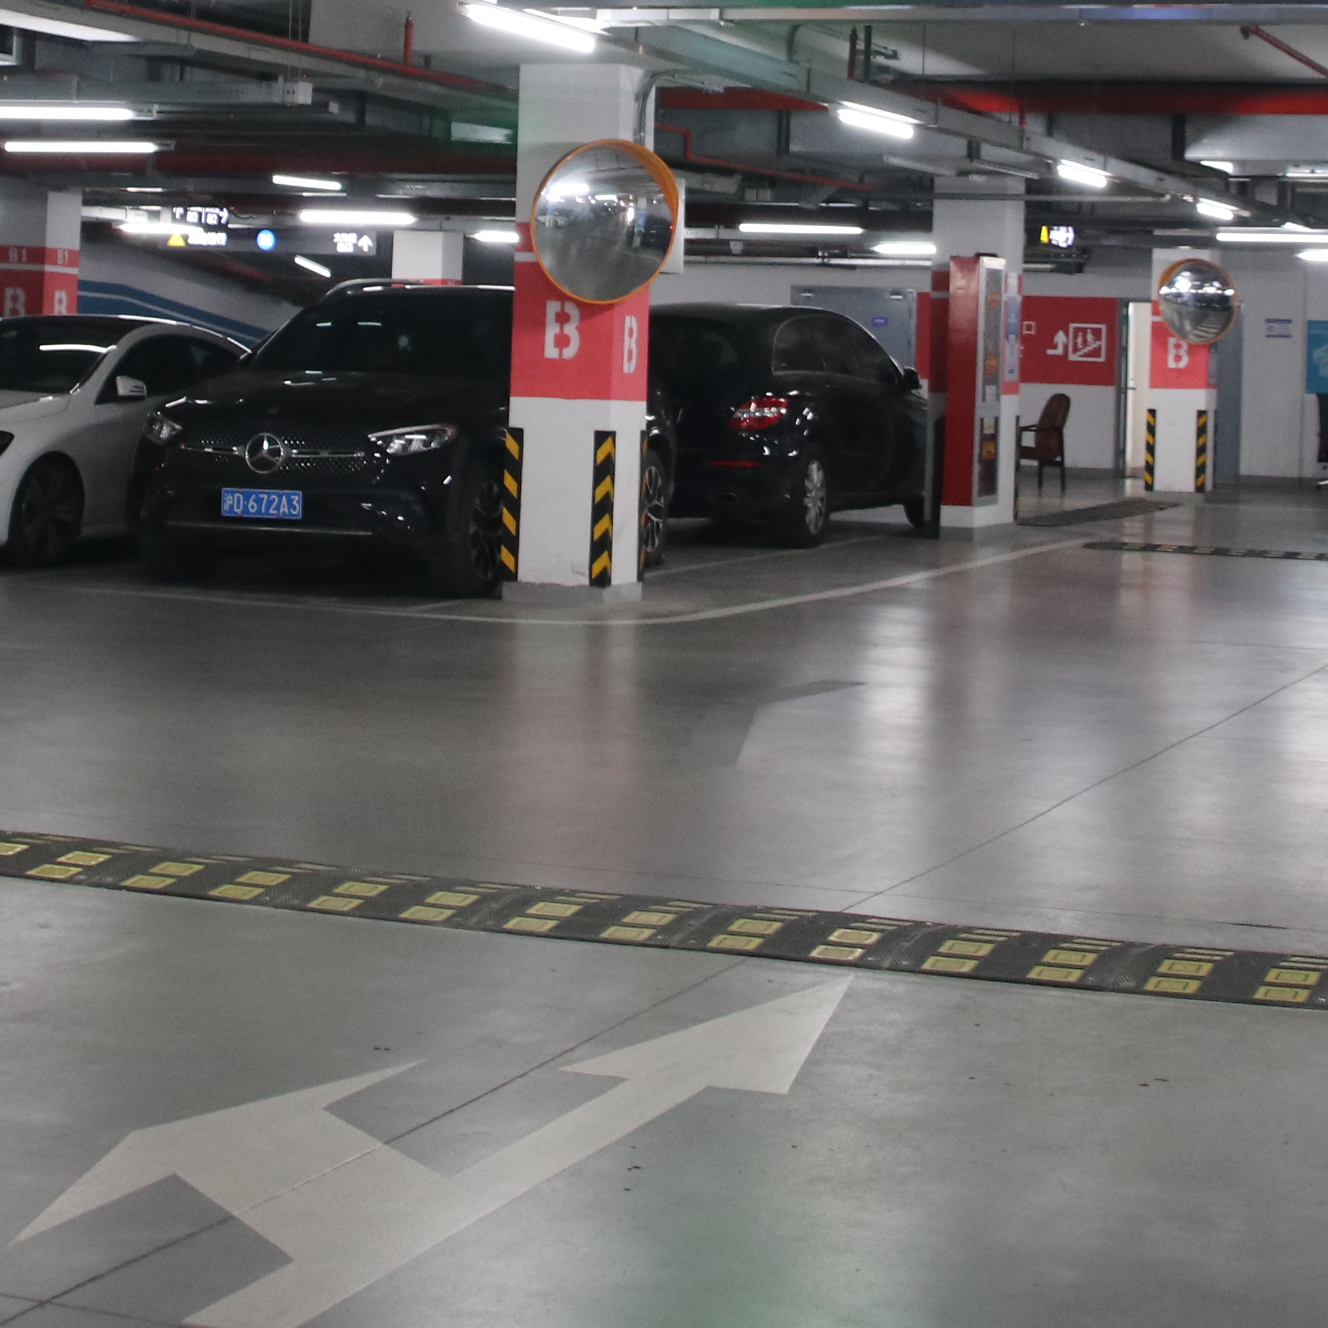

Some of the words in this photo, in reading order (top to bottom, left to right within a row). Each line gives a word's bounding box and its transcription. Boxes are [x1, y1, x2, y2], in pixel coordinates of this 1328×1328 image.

[544, 300, 580, 359] B
[623, 315, 638, 374] B
[1166, 336, 1189, 369] B
